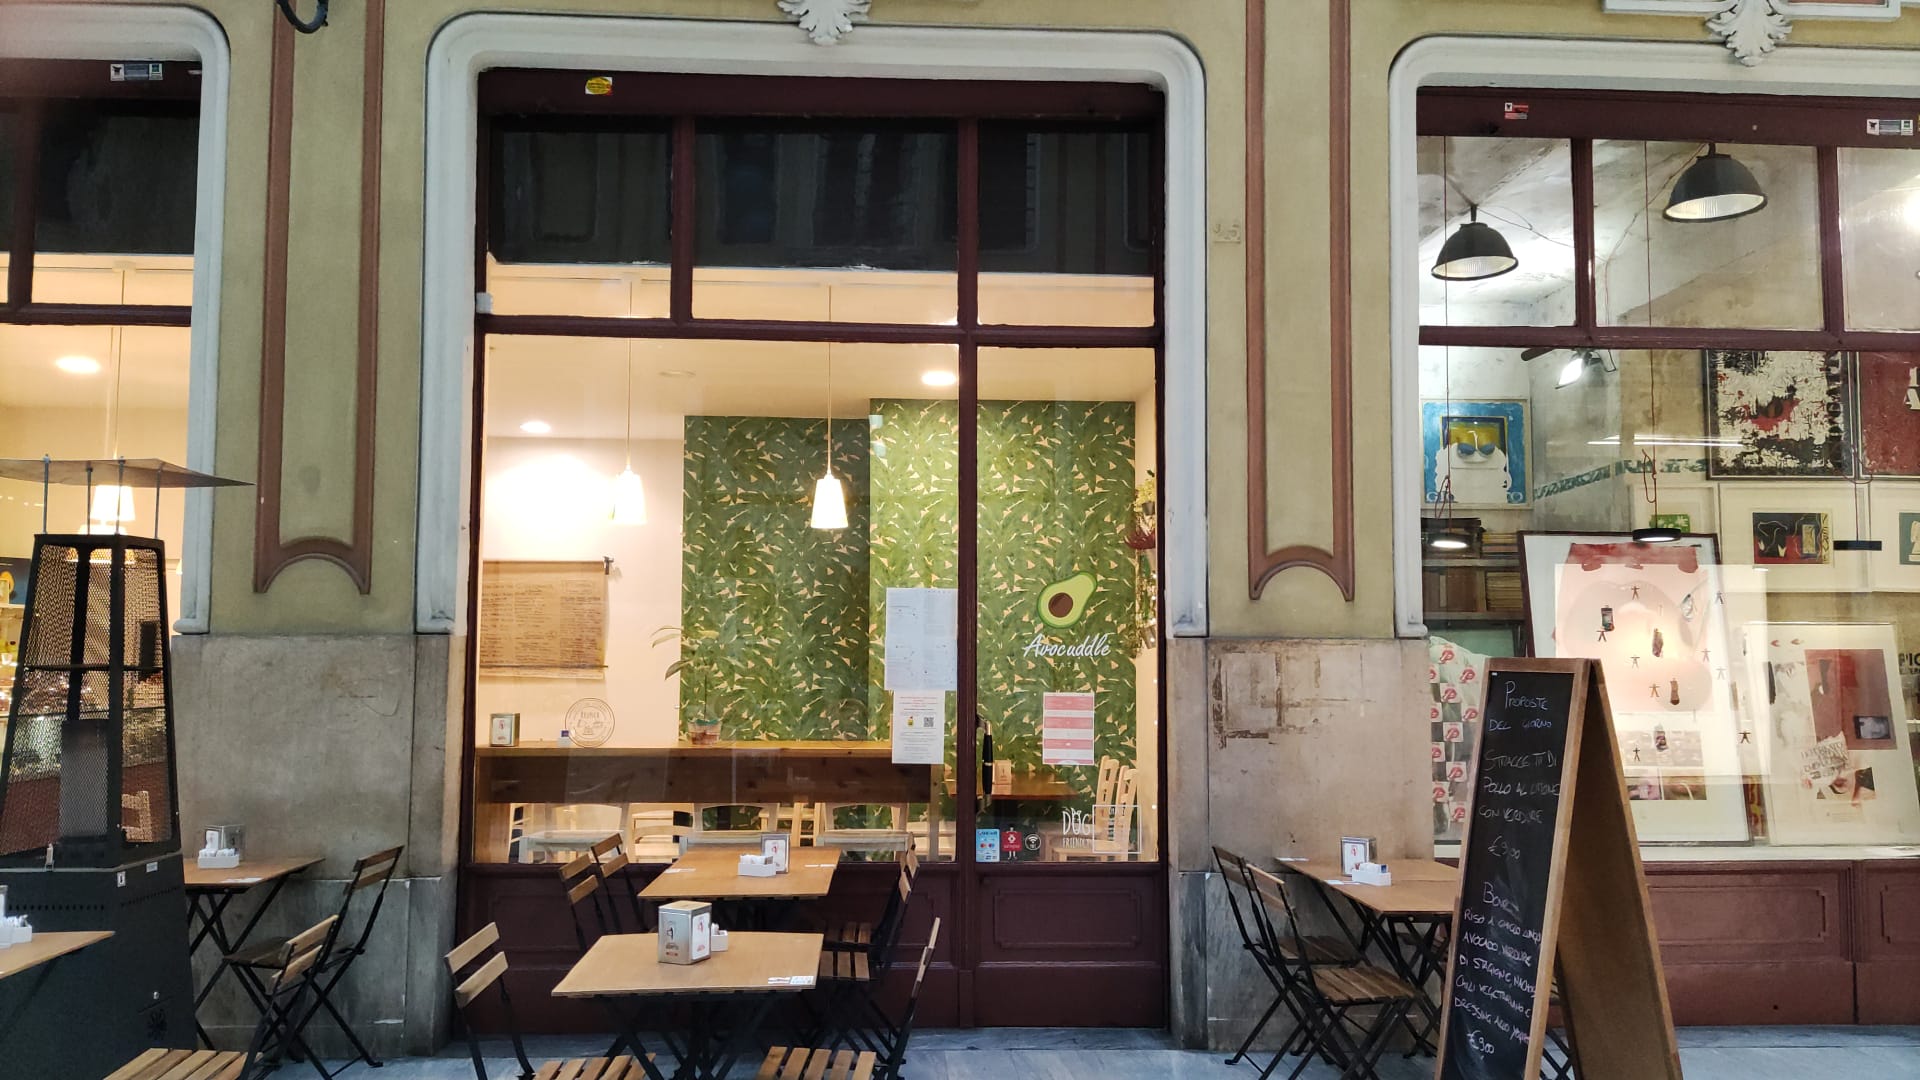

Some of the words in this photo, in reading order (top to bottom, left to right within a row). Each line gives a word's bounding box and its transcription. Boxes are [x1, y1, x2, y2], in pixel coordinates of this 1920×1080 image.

[1022, 632, 1111, 657] Avocuddle
[1488, 719, 1512, 731] DEL
[1483, 776, 1511, 795] POLLO
[1479, 805, 1500, 818] CON
[1062, 807, 1092, 836] DOG
[1464, 908, 1485, 924] RISO
[1460, 954, 1469, 966] DI
